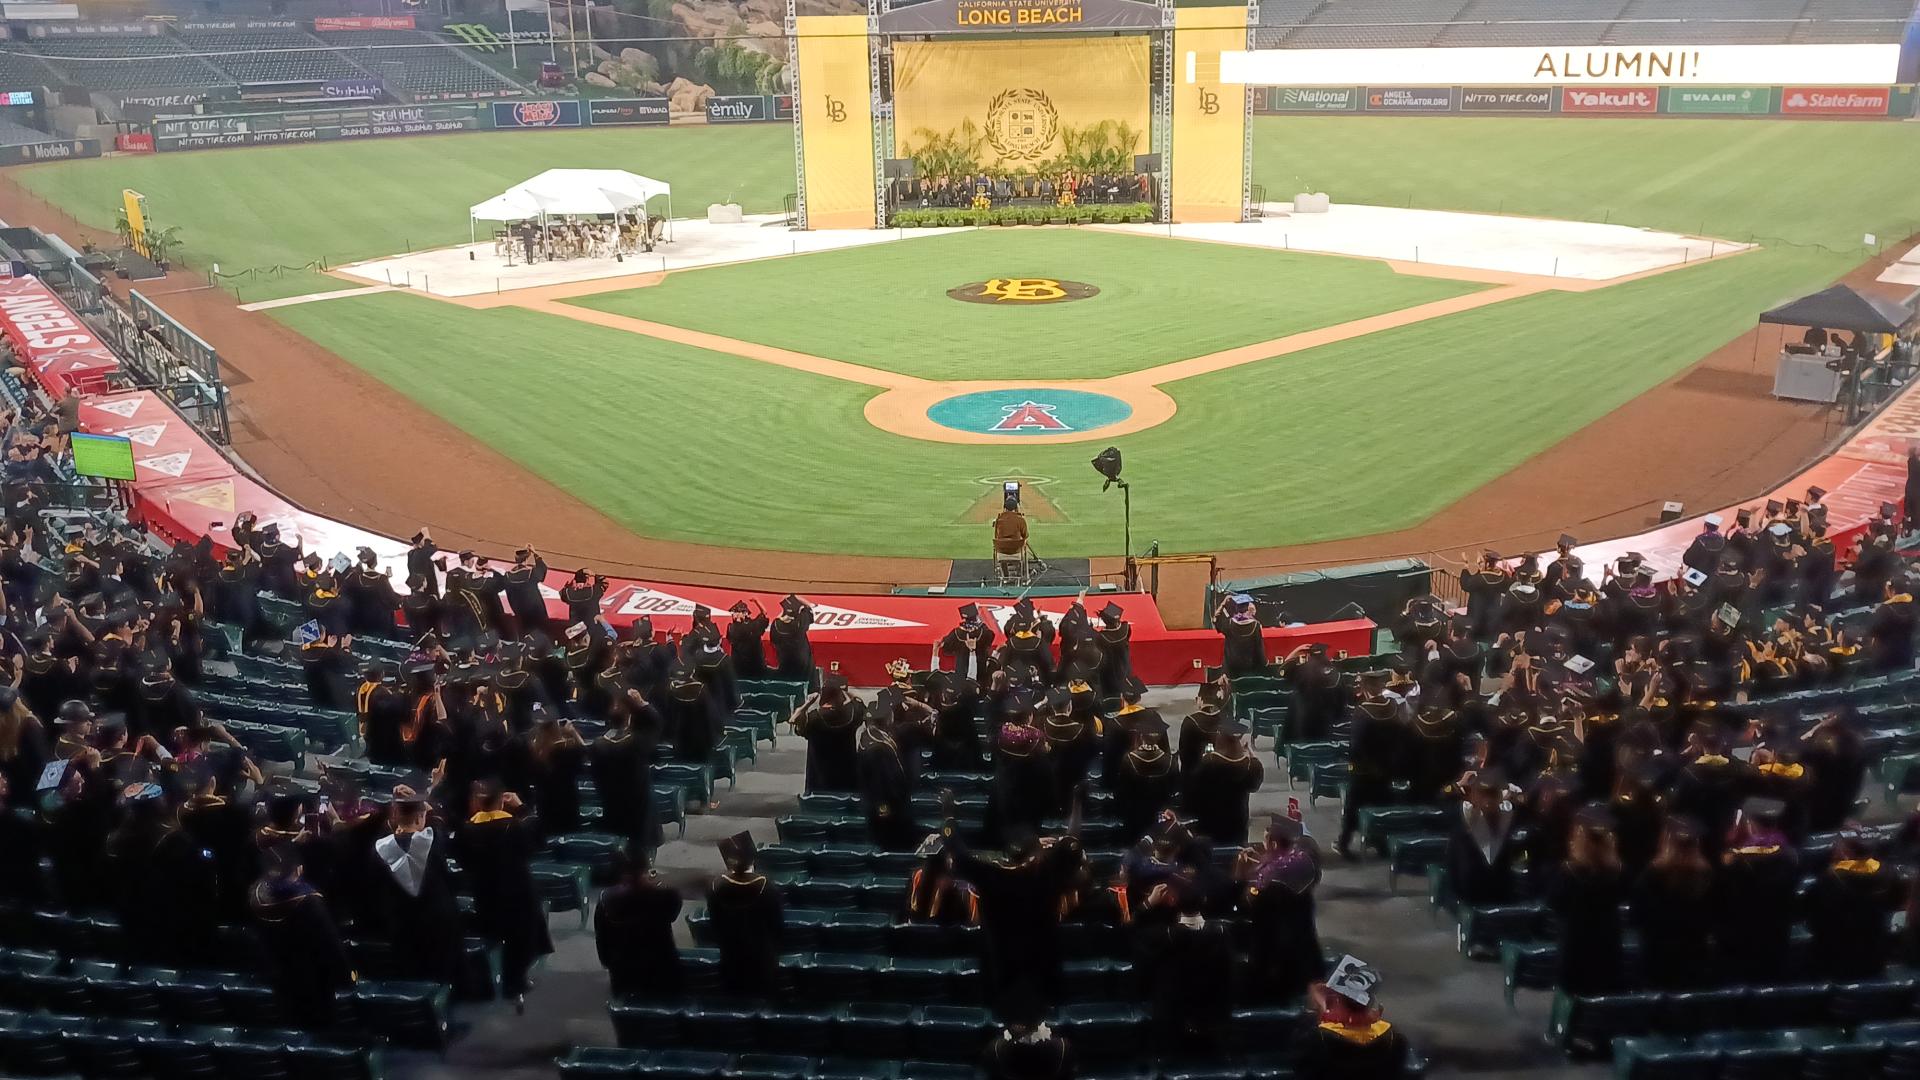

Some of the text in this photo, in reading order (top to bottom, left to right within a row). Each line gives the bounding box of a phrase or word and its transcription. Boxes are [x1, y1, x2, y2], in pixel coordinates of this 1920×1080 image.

[958, 7, 1082, 25] LONG BEACH
[1534, 51, 1700, 78] ALUMNI!
[1298, 89, 1350, 103] National
[1464, 92, 1549, 104] NITTO TIRE.COM
[1568, 91, 1651, 108] Yakult
[179, 130, 316, 147] NITTO TIRE.COM NITTO TIRE.COM
[34, 143, 69, 158] Modelo
[0, 294, 91, 349] ANGELS
